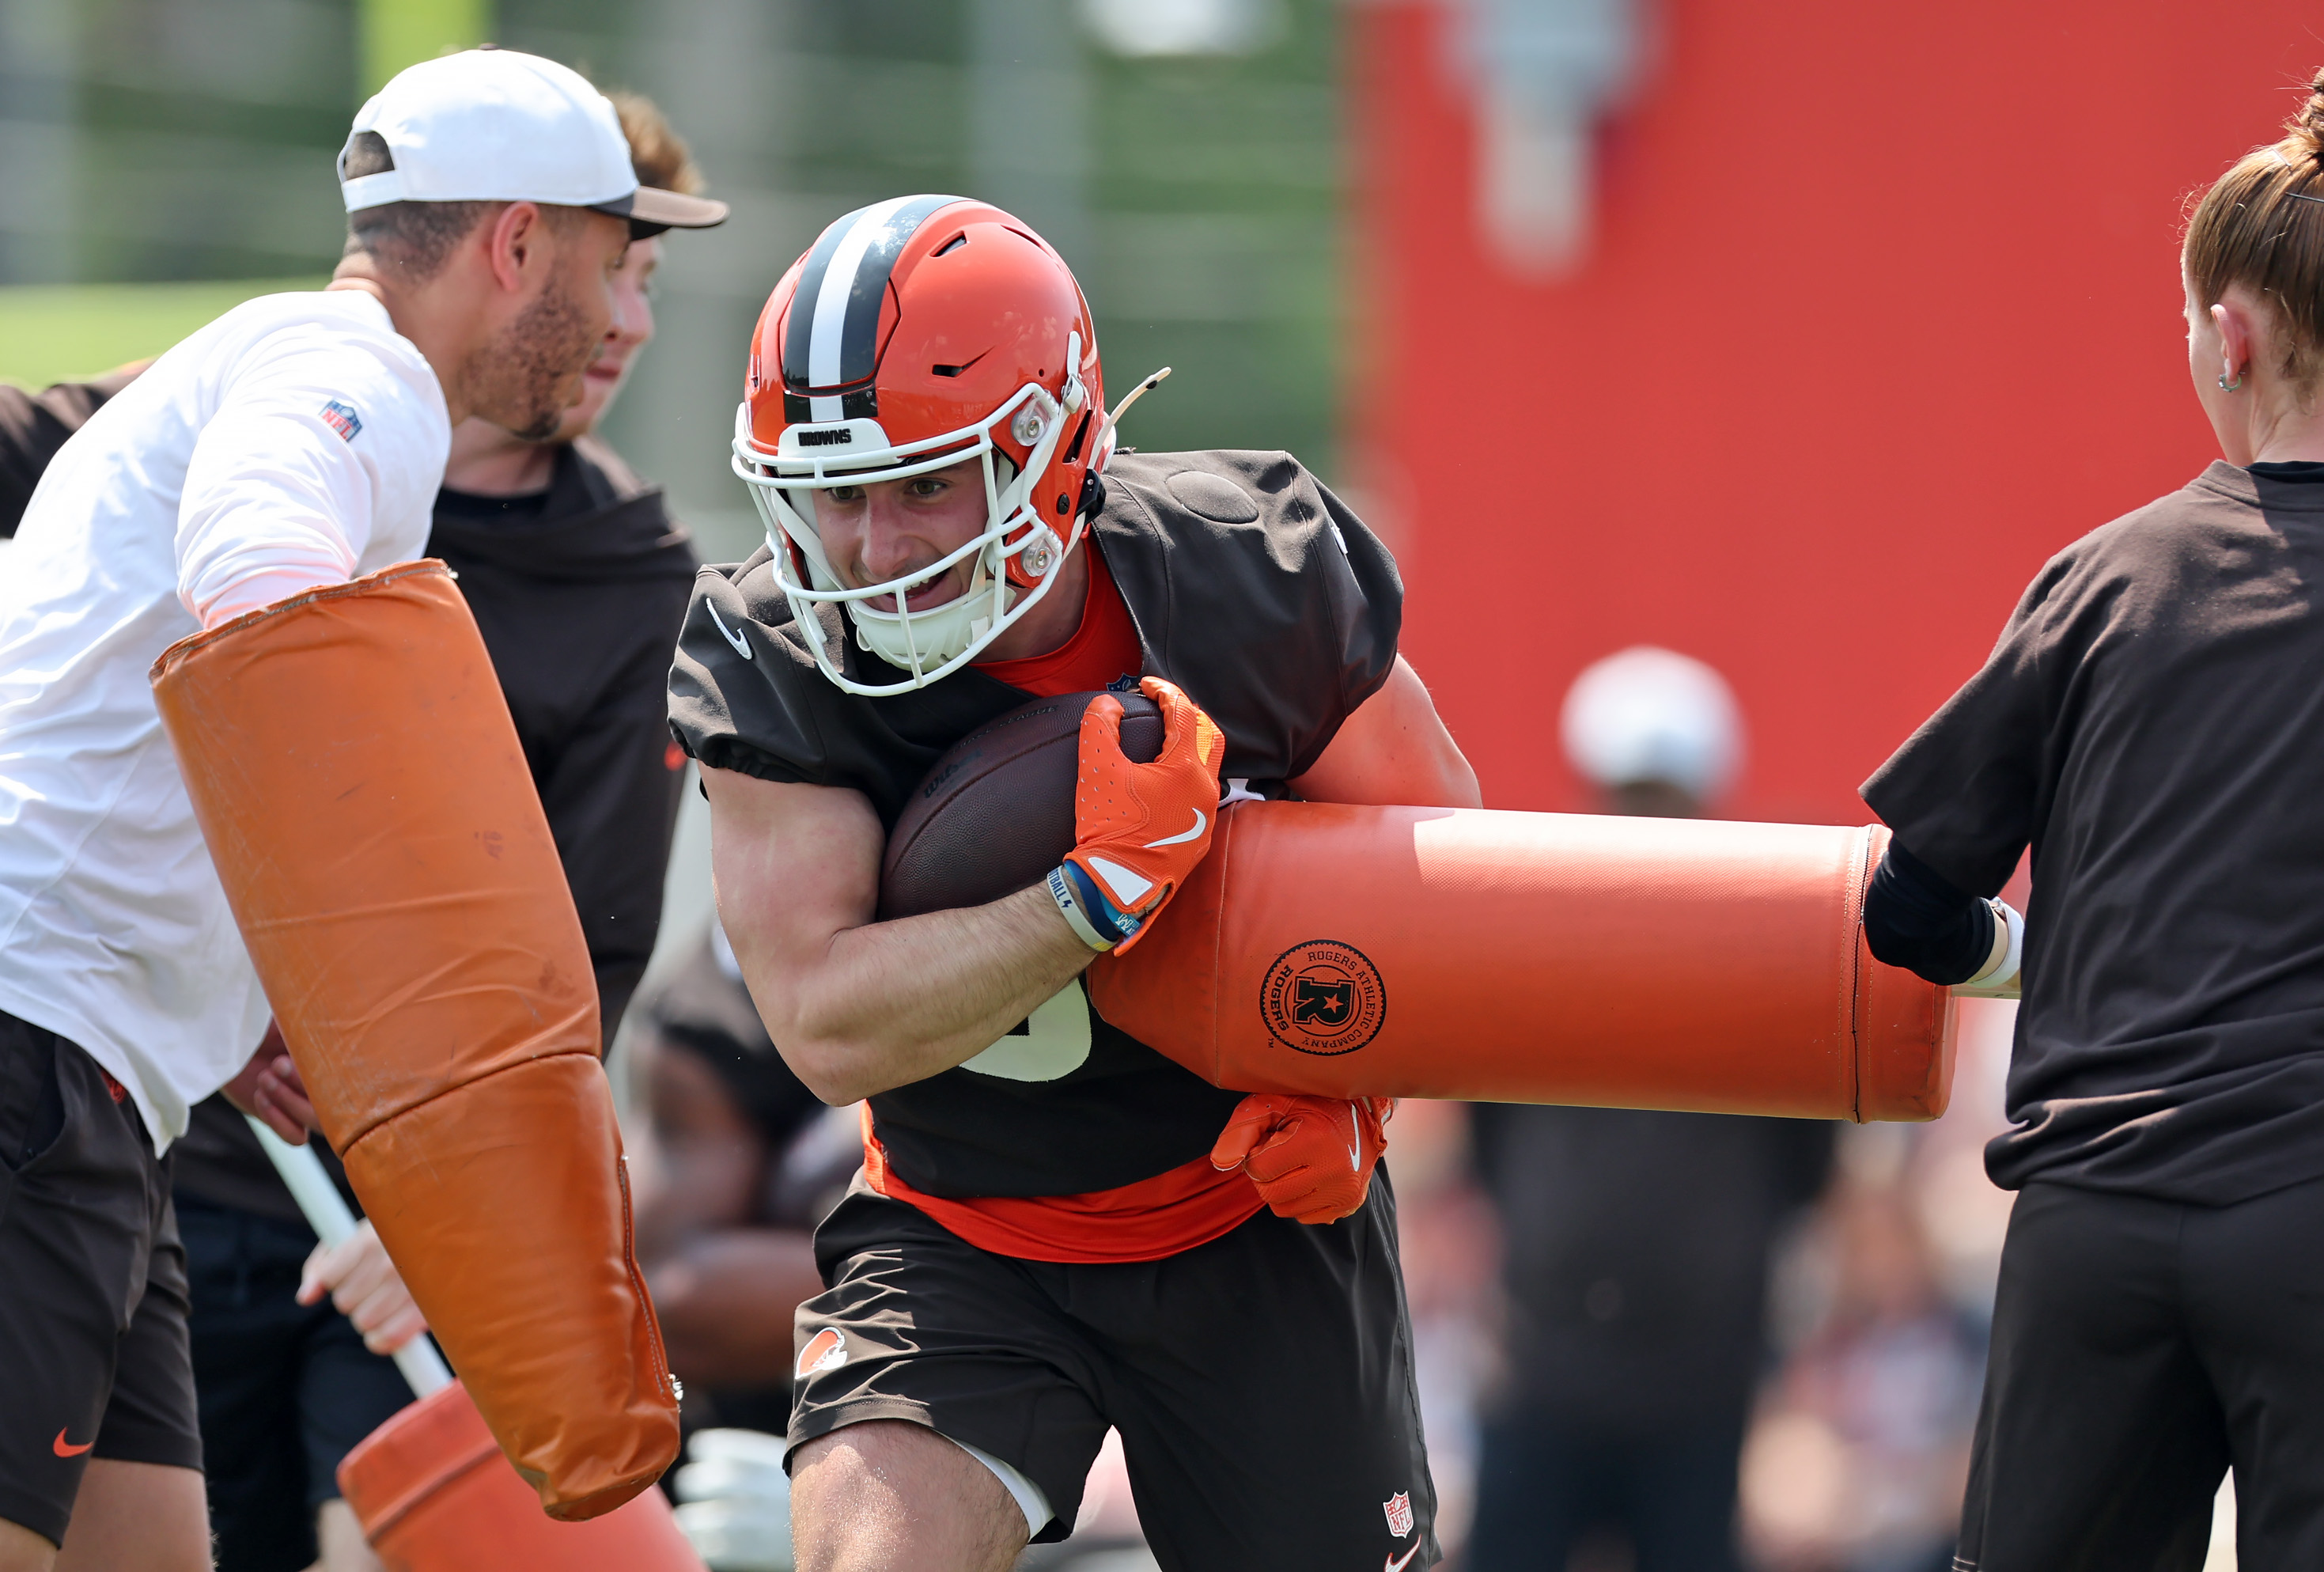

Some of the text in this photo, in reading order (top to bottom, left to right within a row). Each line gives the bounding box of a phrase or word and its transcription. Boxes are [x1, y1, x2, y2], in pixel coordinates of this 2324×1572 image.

[322, 408, 351, 440] NFL
[797, 428, 852, 446] BROWNS
[1270, 964, 1294, 1031] ROGERS
[1293, 975, 1356, 1027] R
[1301, 951, 1376, 1048] ROGERS ATHLETIC COMPANY
[1391, 1509, 1410, 1531] NFL
